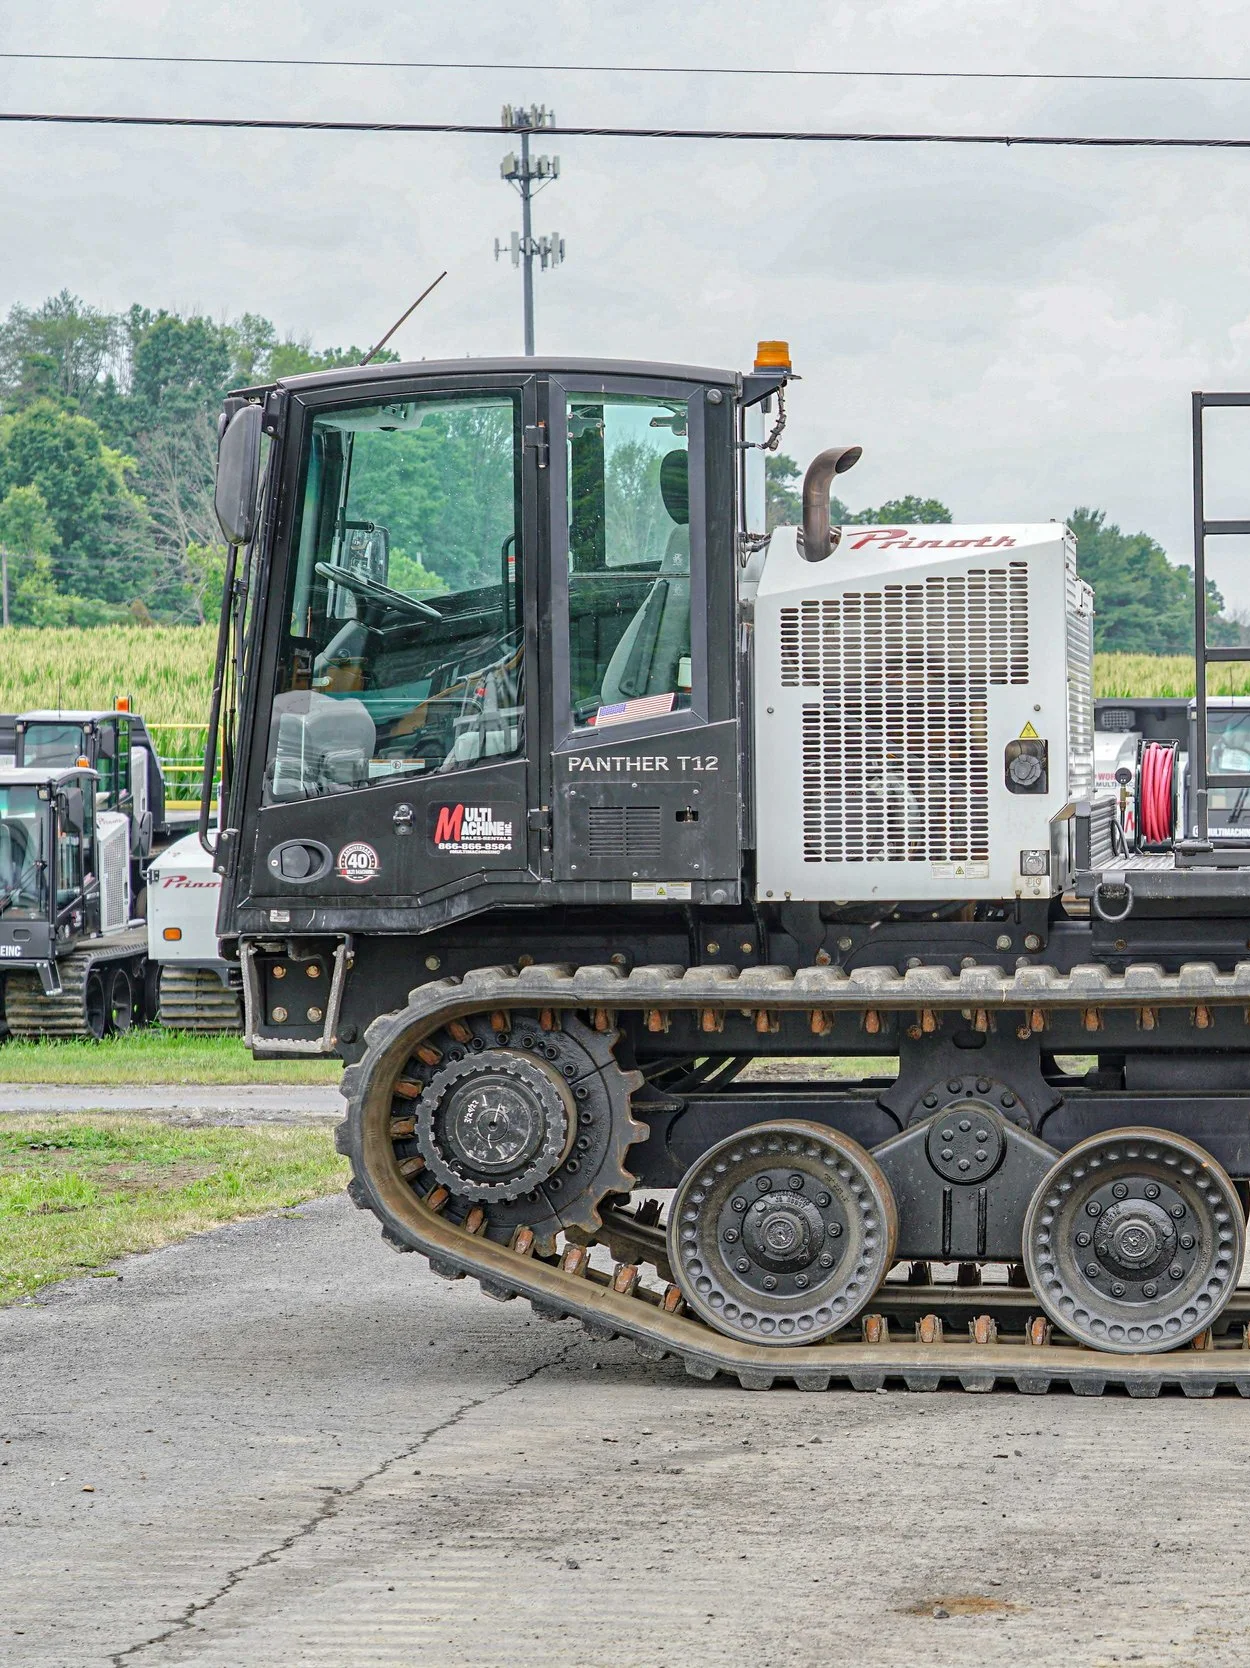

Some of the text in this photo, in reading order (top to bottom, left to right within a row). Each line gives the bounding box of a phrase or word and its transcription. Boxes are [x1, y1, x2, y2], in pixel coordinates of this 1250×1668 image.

[847, 529, 1017, 549] Prinoth
[568, 755, 719, 772] PANTHER T12
[438, 842, 512, 851] 866-866-8584
[347, 853, 369, 869] 40
